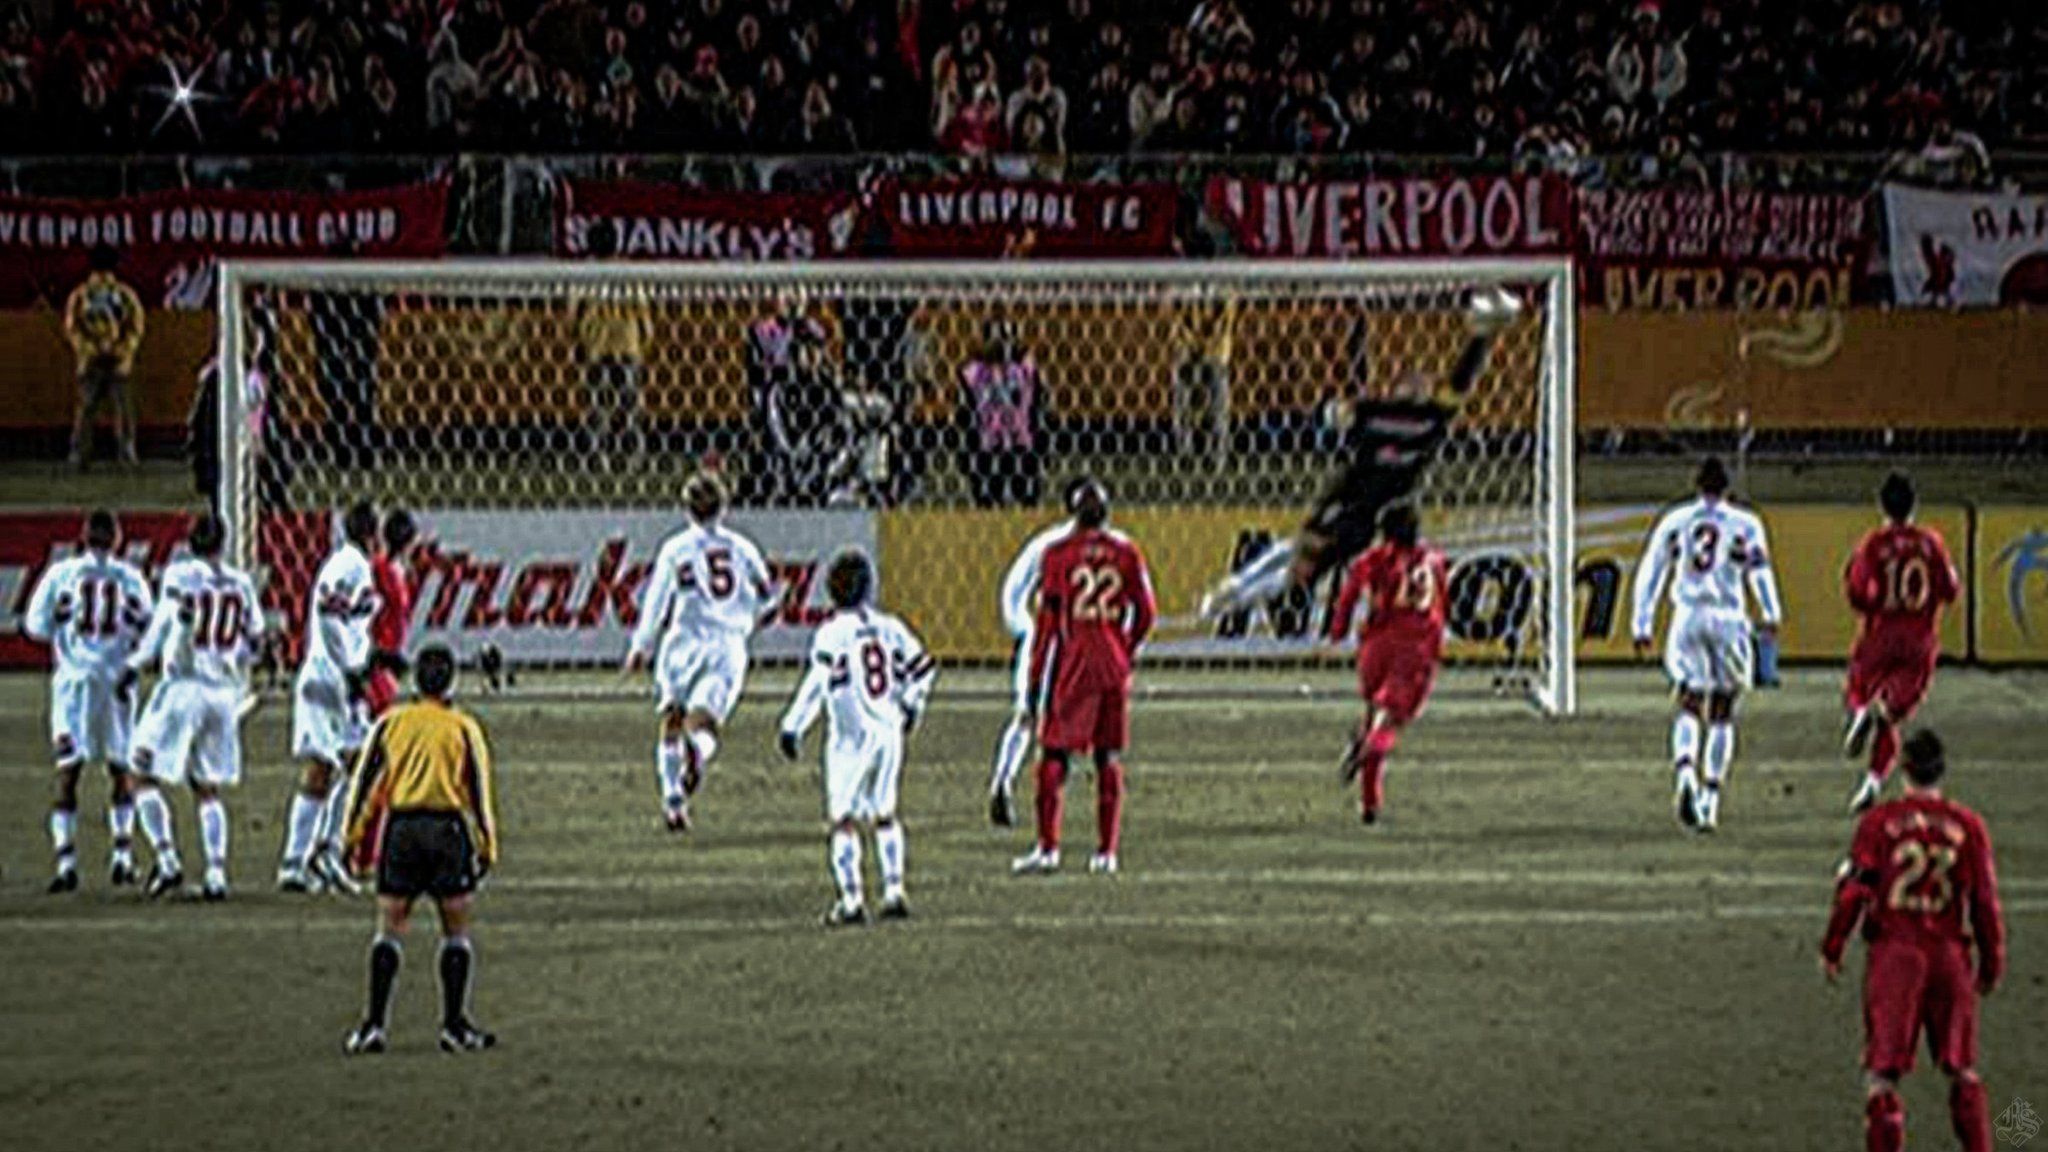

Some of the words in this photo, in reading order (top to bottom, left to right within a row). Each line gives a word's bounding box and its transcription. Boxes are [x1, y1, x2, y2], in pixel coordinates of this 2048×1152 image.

[151, 207, 300, 245] FOOTBALL
[899, 190, 1078, 230] LIVERPOOL
[1100, 195, 1142, 231] FC
[705, 547, 736, 602] 5
[1690, 521, 1721, 573] 3
[77, 578, 119, 637] 11
[1070, 562, 1123, 622] 22
[1882, 555, 1932, 612] 10
[194, 588, 244, 651] 10
[860, 639, 889, 701] 8
[1887, 838, 1958, 913] 23
